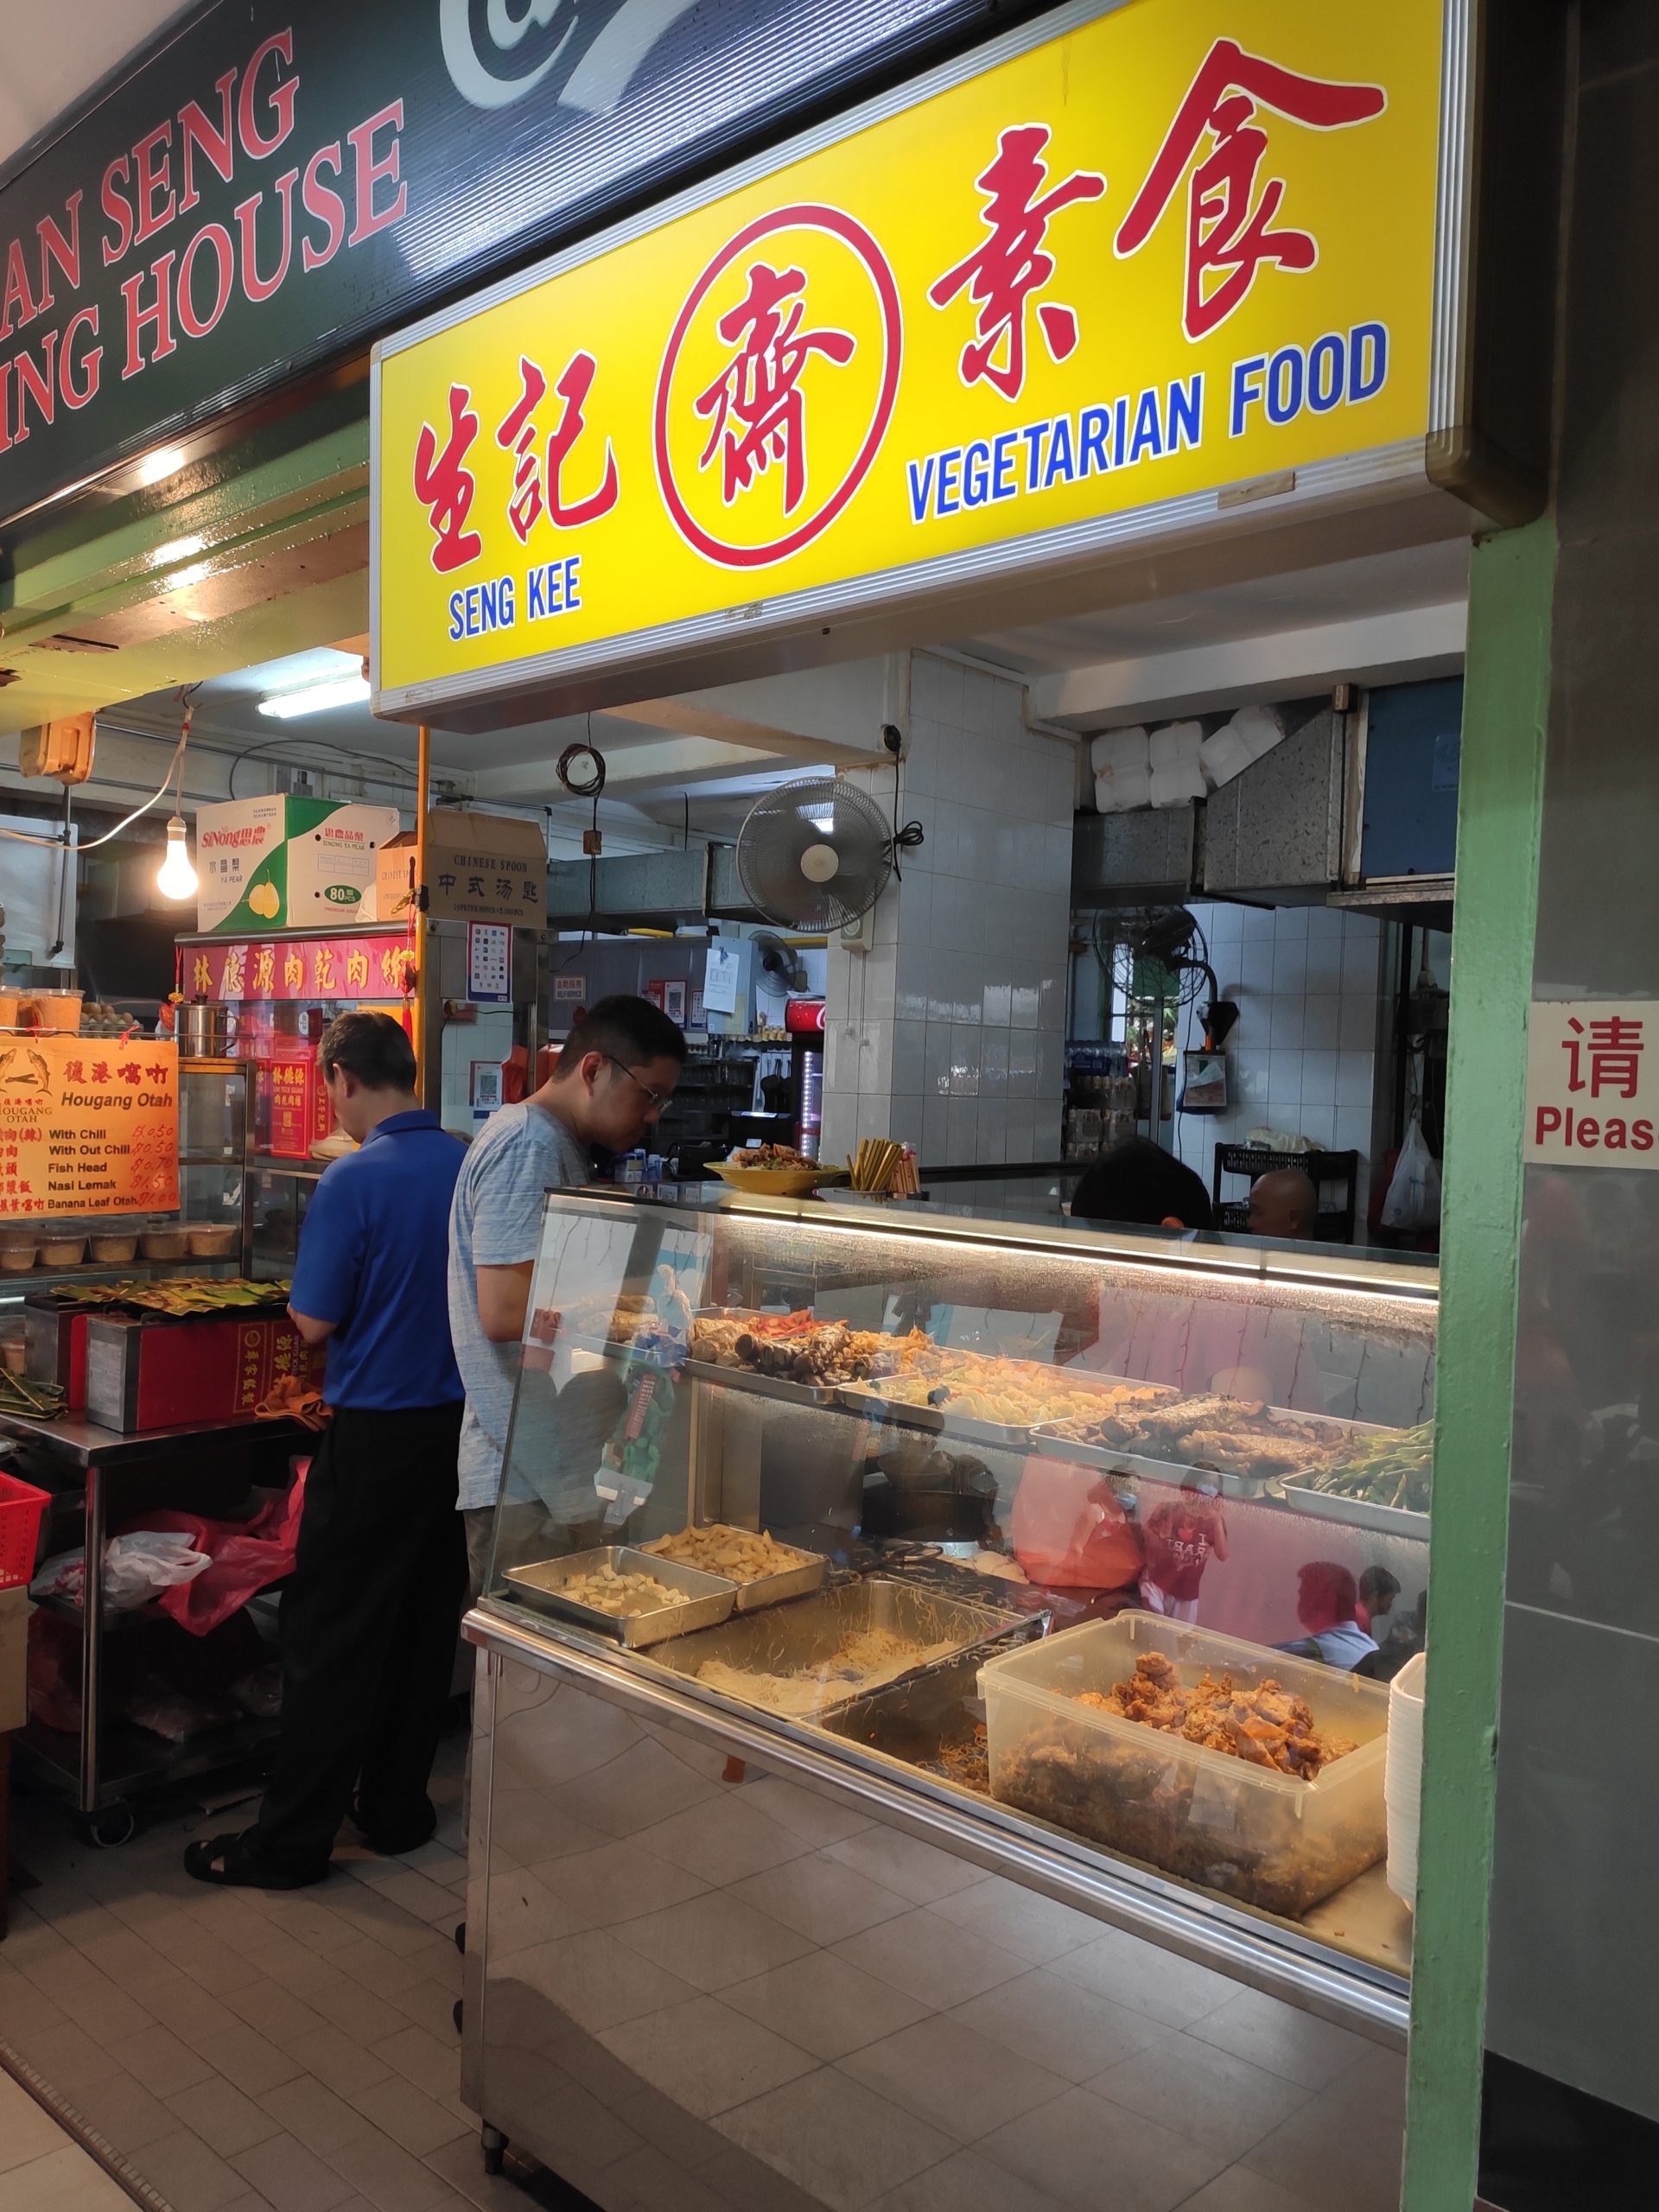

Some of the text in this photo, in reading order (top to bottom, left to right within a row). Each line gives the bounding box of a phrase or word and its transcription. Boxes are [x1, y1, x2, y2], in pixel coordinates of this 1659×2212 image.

[101, 26, 300, 267] SENG
[926, 37, 1388, 403] 素食
[121, 97, 408, 380] HOUSE
[906, 321, 1390, 525] VEGETARIAN FOOD
[448, 554, 582, 640] SENG KEE
[454, 855, 527, 873] CHINESE SPOON
[330, 887, 345, 901] 80
[438, 873, 539, 903] 中式汤匙
[1561, 1016, 1644, 1099] 请
[61, 1092, 173, 1110] Hougang Otah
[49, 1129, 76, 1140] With
[1535, 1106, 1659, 1151] Pleas
[48, 1145, 76, 1155] With
[79, 1145, 102, 1155] Out
[48, 1162, 108, 1173] Fish Head
[48, 1179, 117, 1191] Nasi Lemak
[48, 1197, 137, 1210] Banana Leaf Otah
